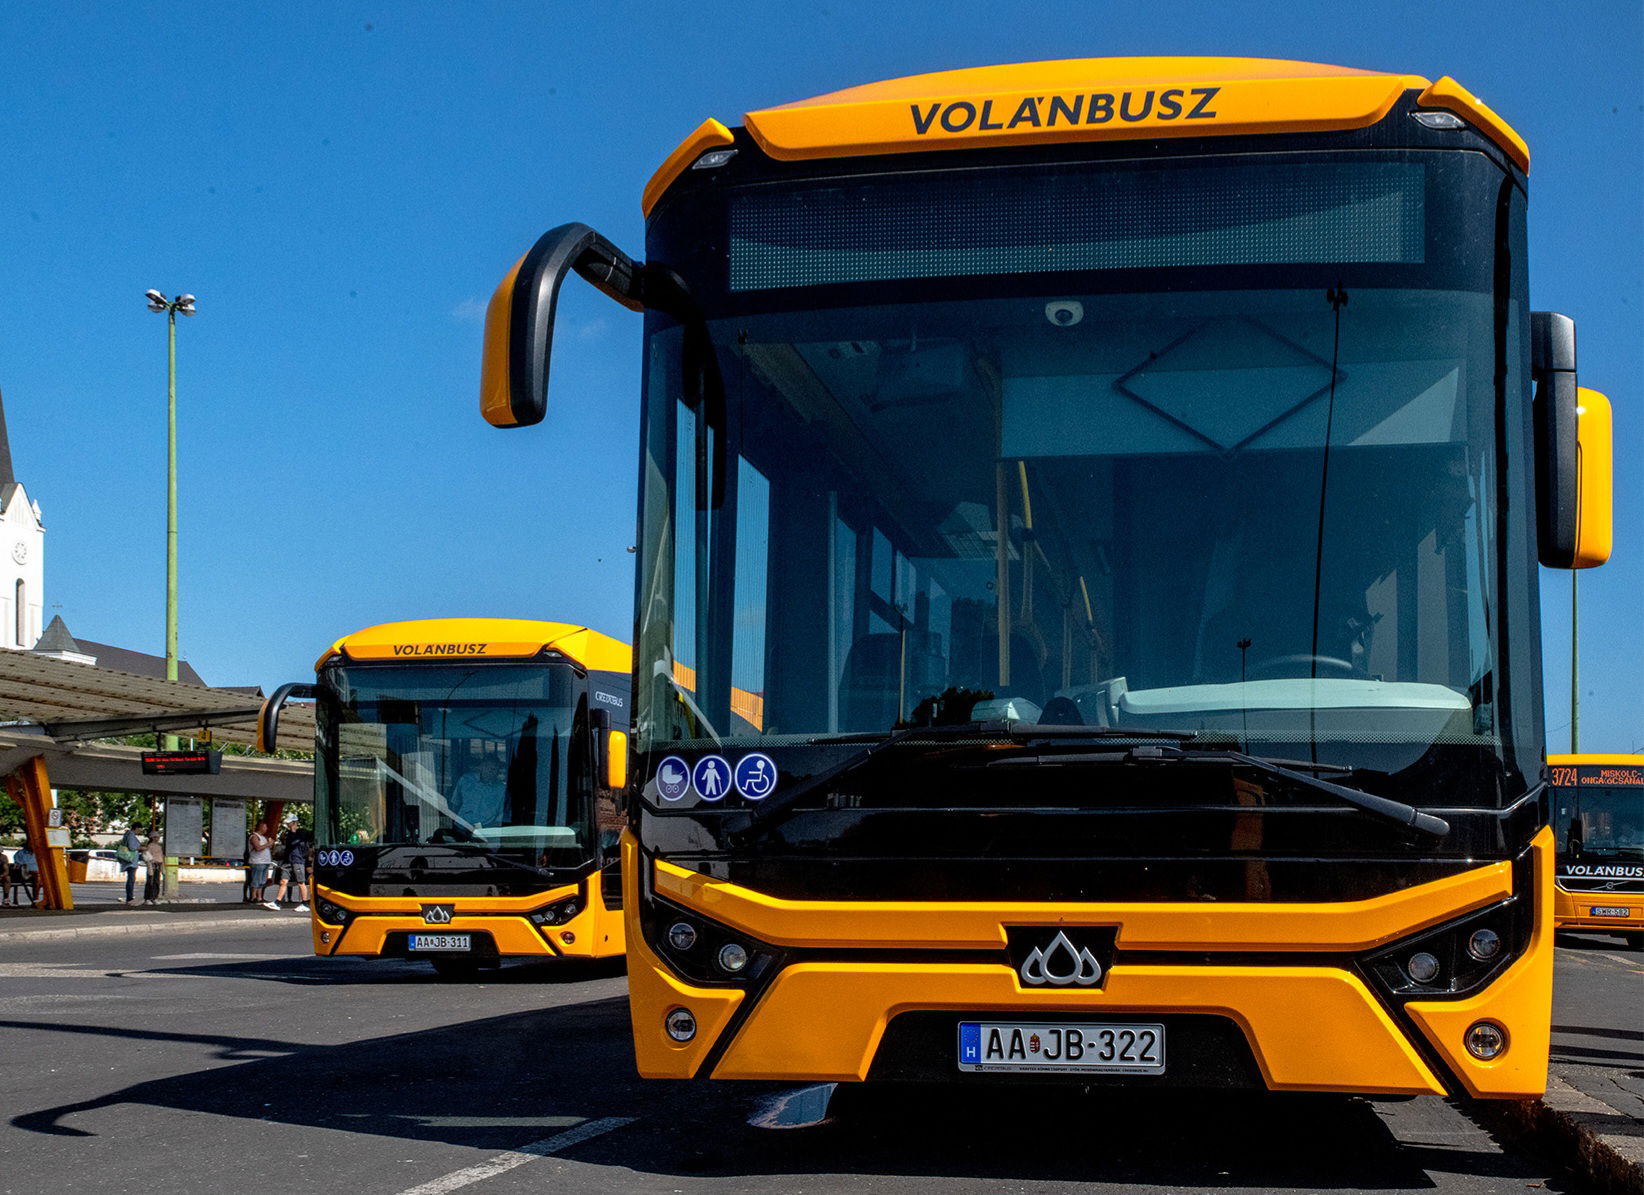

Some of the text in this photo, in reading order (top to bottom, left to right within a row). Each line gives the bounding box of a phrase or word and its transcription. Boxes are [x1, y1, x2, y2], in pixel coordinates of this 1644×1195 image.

[910, 87, 1221, 135] VOLÁNBUSZ
[393, 643, 487, 656] VOLÁNBUSZ
[1552, 767, 1577, 786] 3724
[1565, 864, 1644, 877] VOLÁNBUS
[966, 1046, 976, 1058] H
[986, 1028, 1157, 1062] AA JB-322
